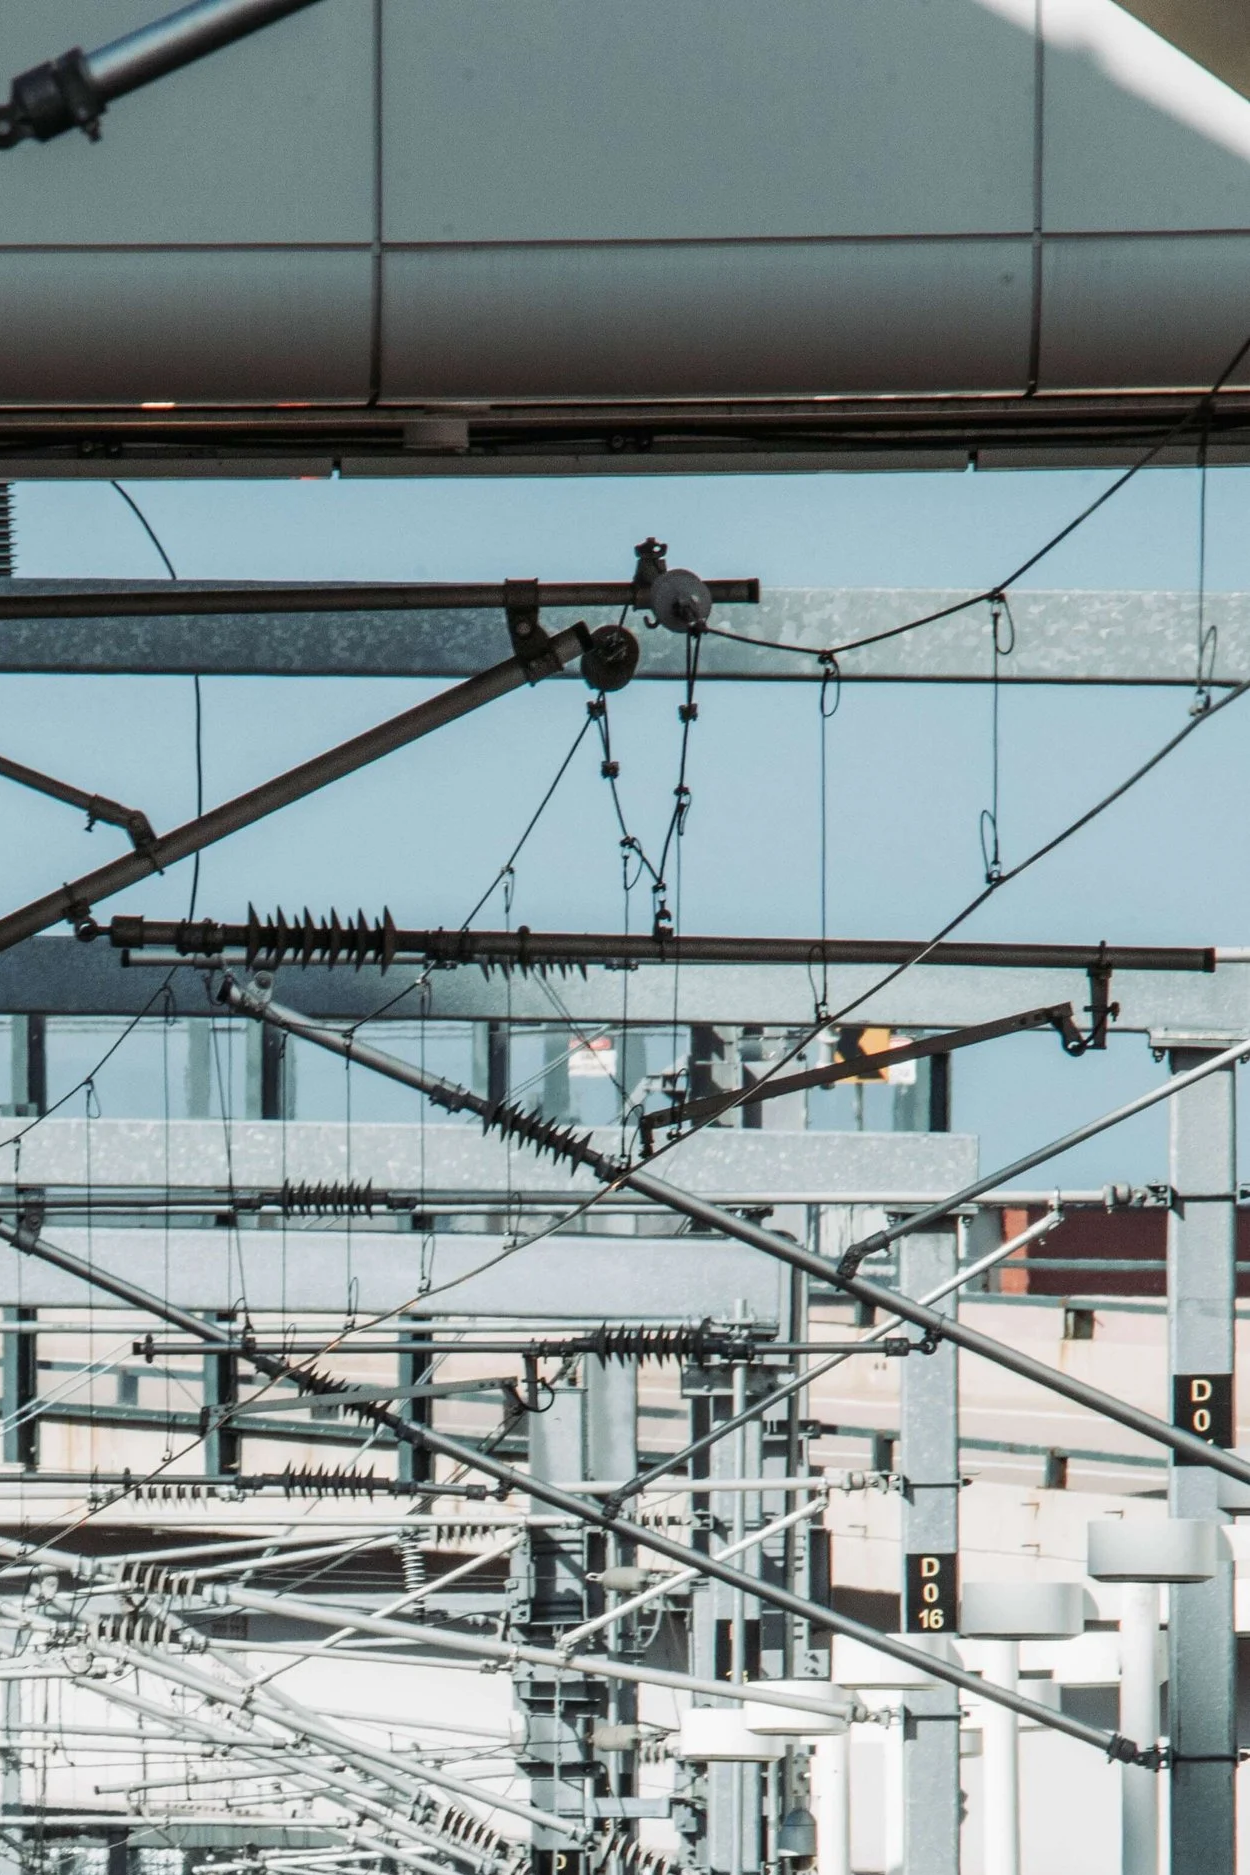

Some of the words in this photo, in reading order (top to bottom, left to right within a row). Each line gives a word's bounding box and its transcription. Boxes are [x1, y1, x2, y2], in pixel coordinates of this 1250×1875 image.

[1191, 1380, 1211, 1401] D
[1193, 1410, 1211, 1431] 0
[921, 1558, 940, 1577] D
[923, 1584, 939, 1603] 0
[918, 1609, 944, 1629] 16
